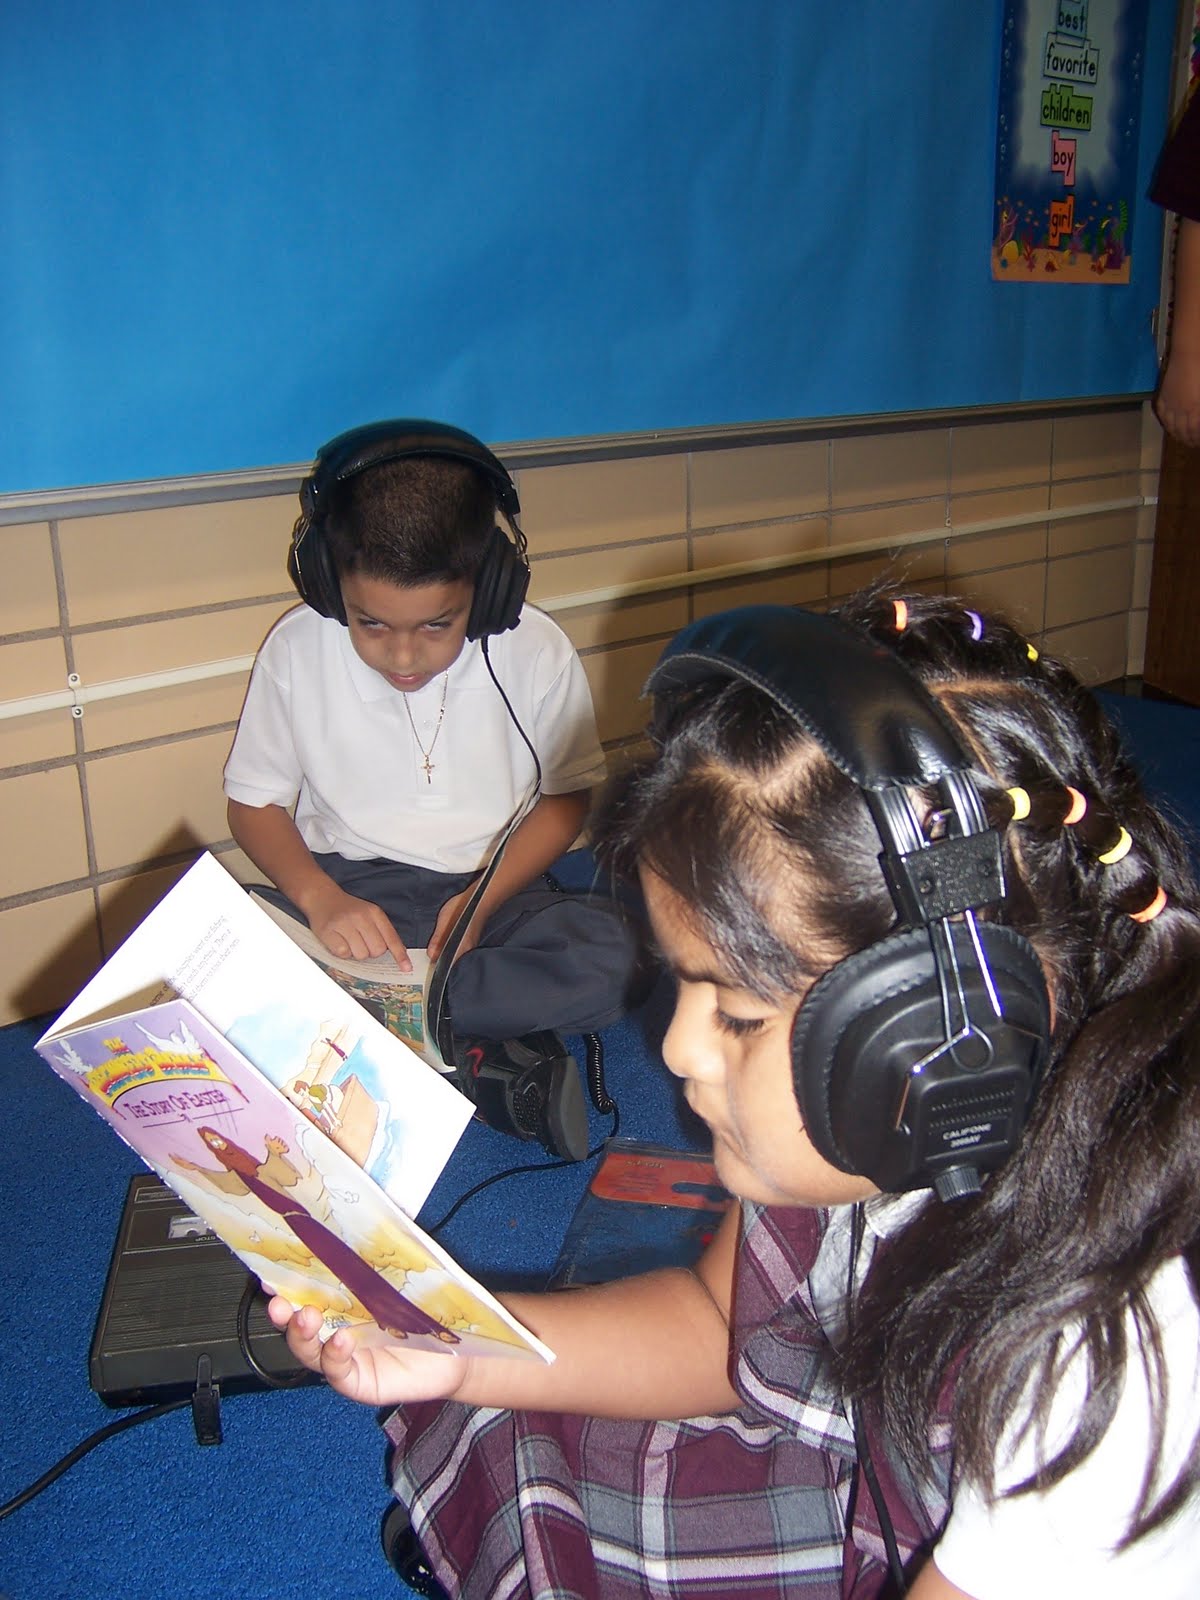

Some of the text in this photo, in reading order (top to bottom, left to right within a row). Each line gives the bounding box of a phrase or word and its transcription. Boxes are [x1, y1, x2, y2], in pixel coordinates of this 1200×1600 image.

[1057, 3, 1085, 33] best
[1046, 42, 1096, 77] favorite
[1042, 93, 1090, 125] children
[1053, 141, 1074, 176] boy
[1051, 204, 1072, 238] girl
[942, 1123, 992, 1140] CALIFONE
